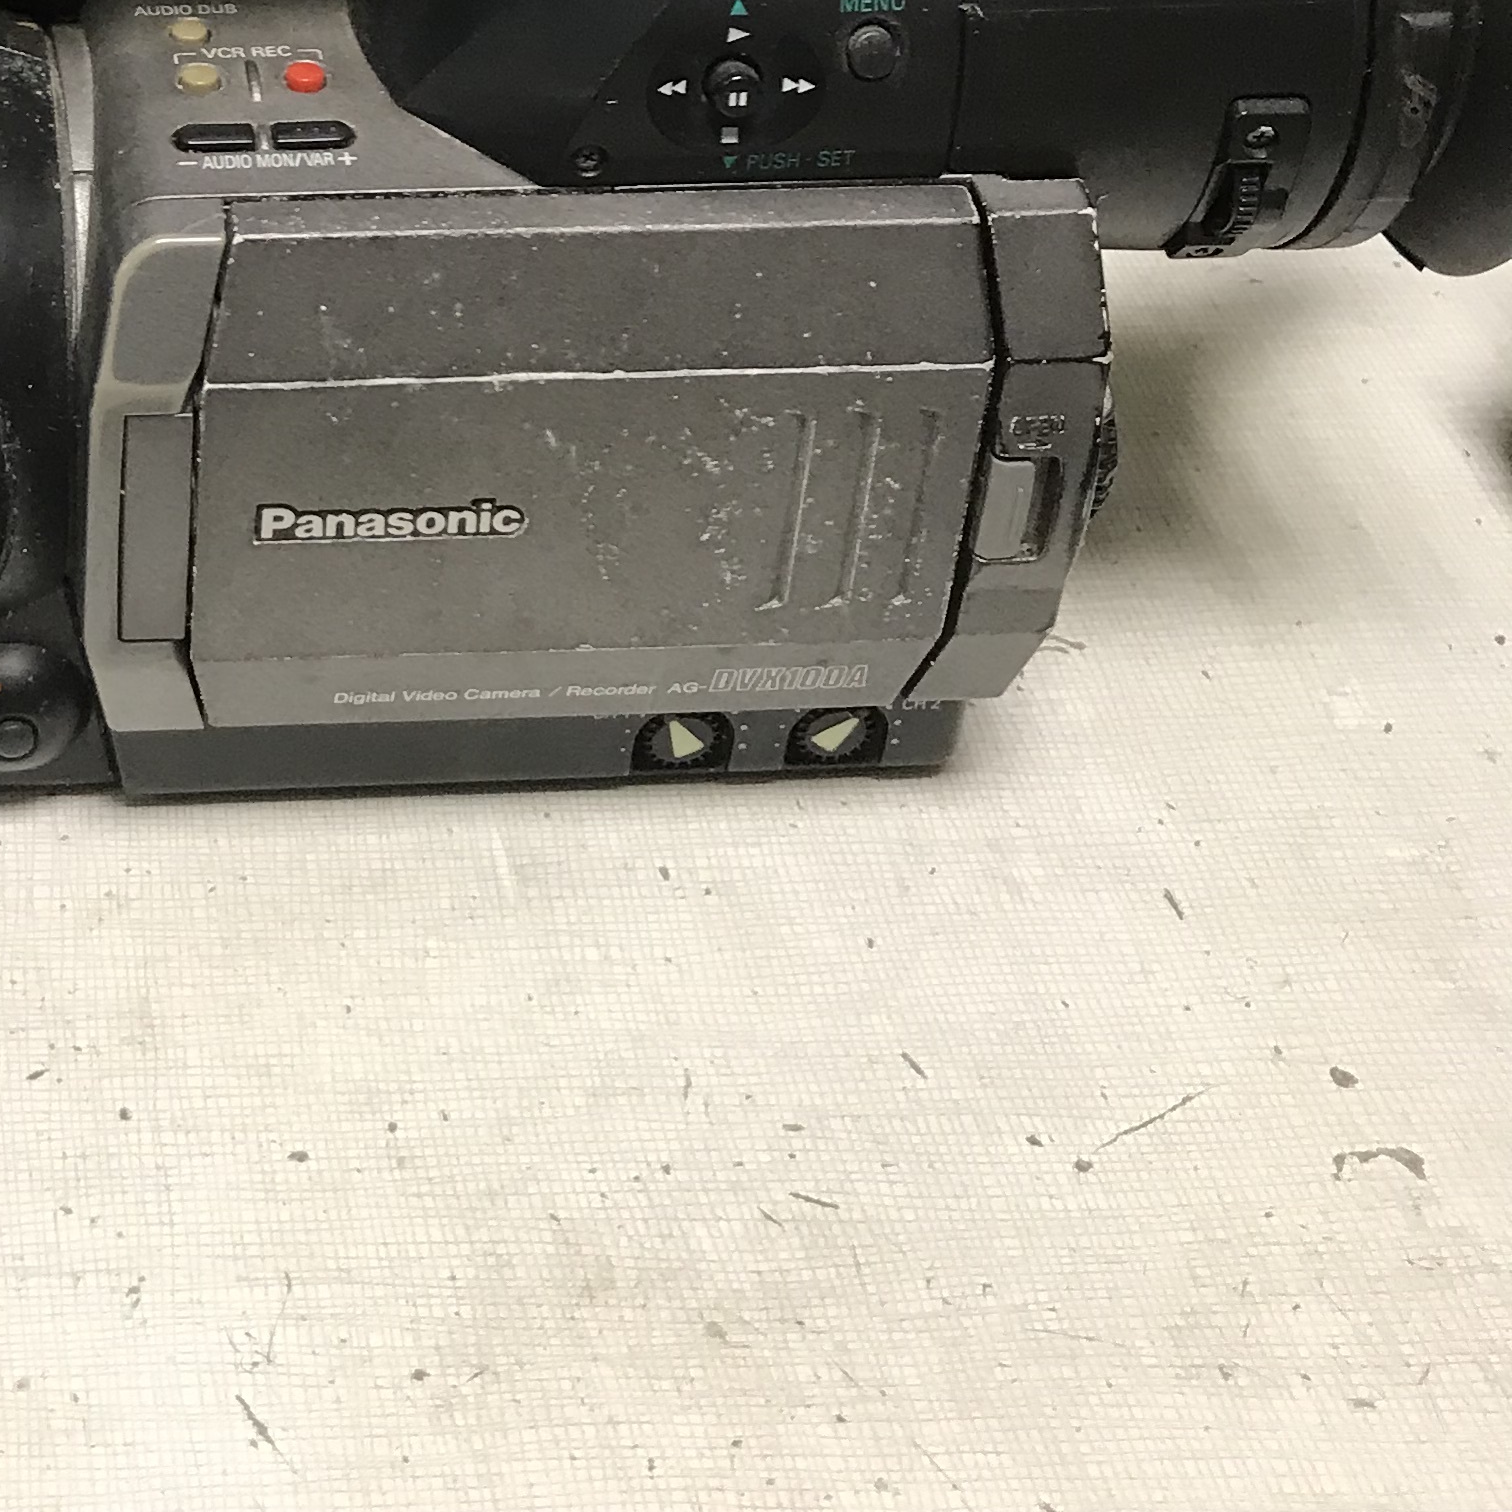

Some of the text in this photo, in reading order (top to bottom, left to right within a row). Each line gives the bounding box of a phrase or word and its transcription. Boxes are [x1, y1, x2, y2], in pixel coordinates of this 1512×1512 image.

[134, 3, 238, 17] AUDIO DUB
[201, 45, 293, 59] VCR REC
[202, 154, 253, 170] AUDIO
[256, 151, 335, 169] MON/VAR
[746, 152, 800, 170] PUSH
[816, 149, 855, 168] SET
[260, 502, 522, 539] Panasonic
[333, 691, 395, 705] Digital
[402, 689, 458, 702] Video
[464, 687, 541, 700] Camera
[566, 683, 657, 697] Recorder
